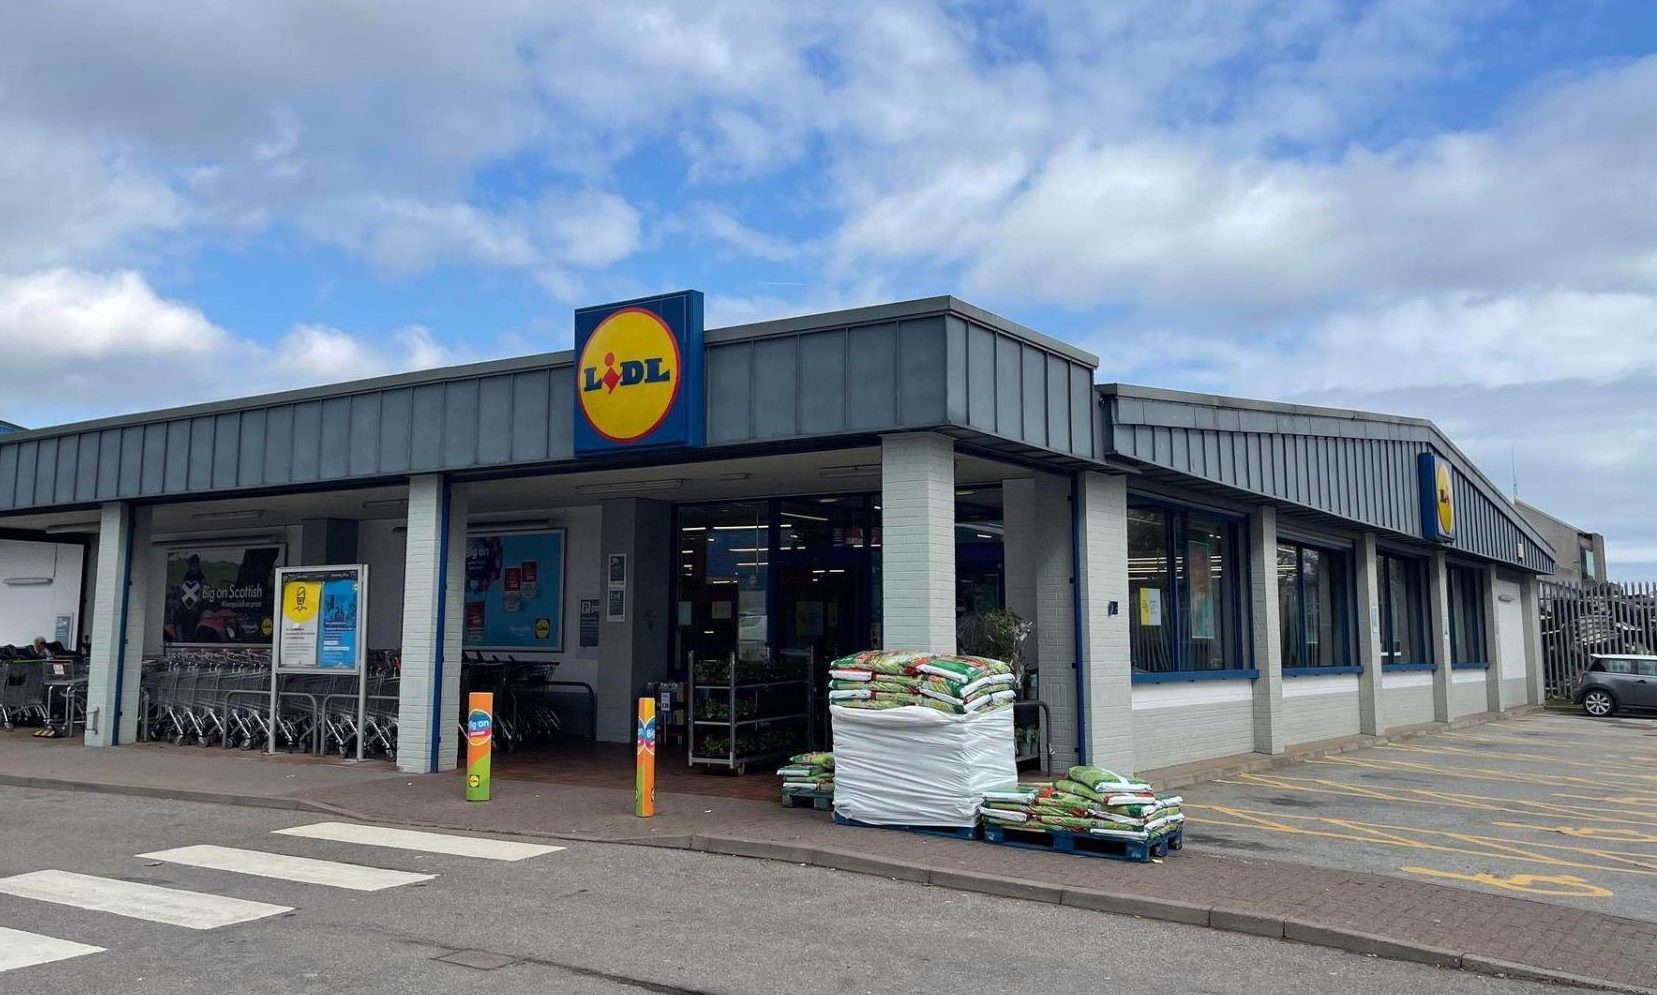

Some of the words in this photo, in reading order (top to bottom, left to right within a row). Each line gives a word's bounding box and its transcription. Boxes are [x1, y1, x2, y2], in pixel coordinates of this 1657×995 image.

[479, 548, 490, 557] on
[202, 584, 215, 602] Big
[216, 588, 228, 599] on
[229, 583, 262, 599] Scottish
[469, 720, 477, 730] ig
[478, 720, 489, 728] on
